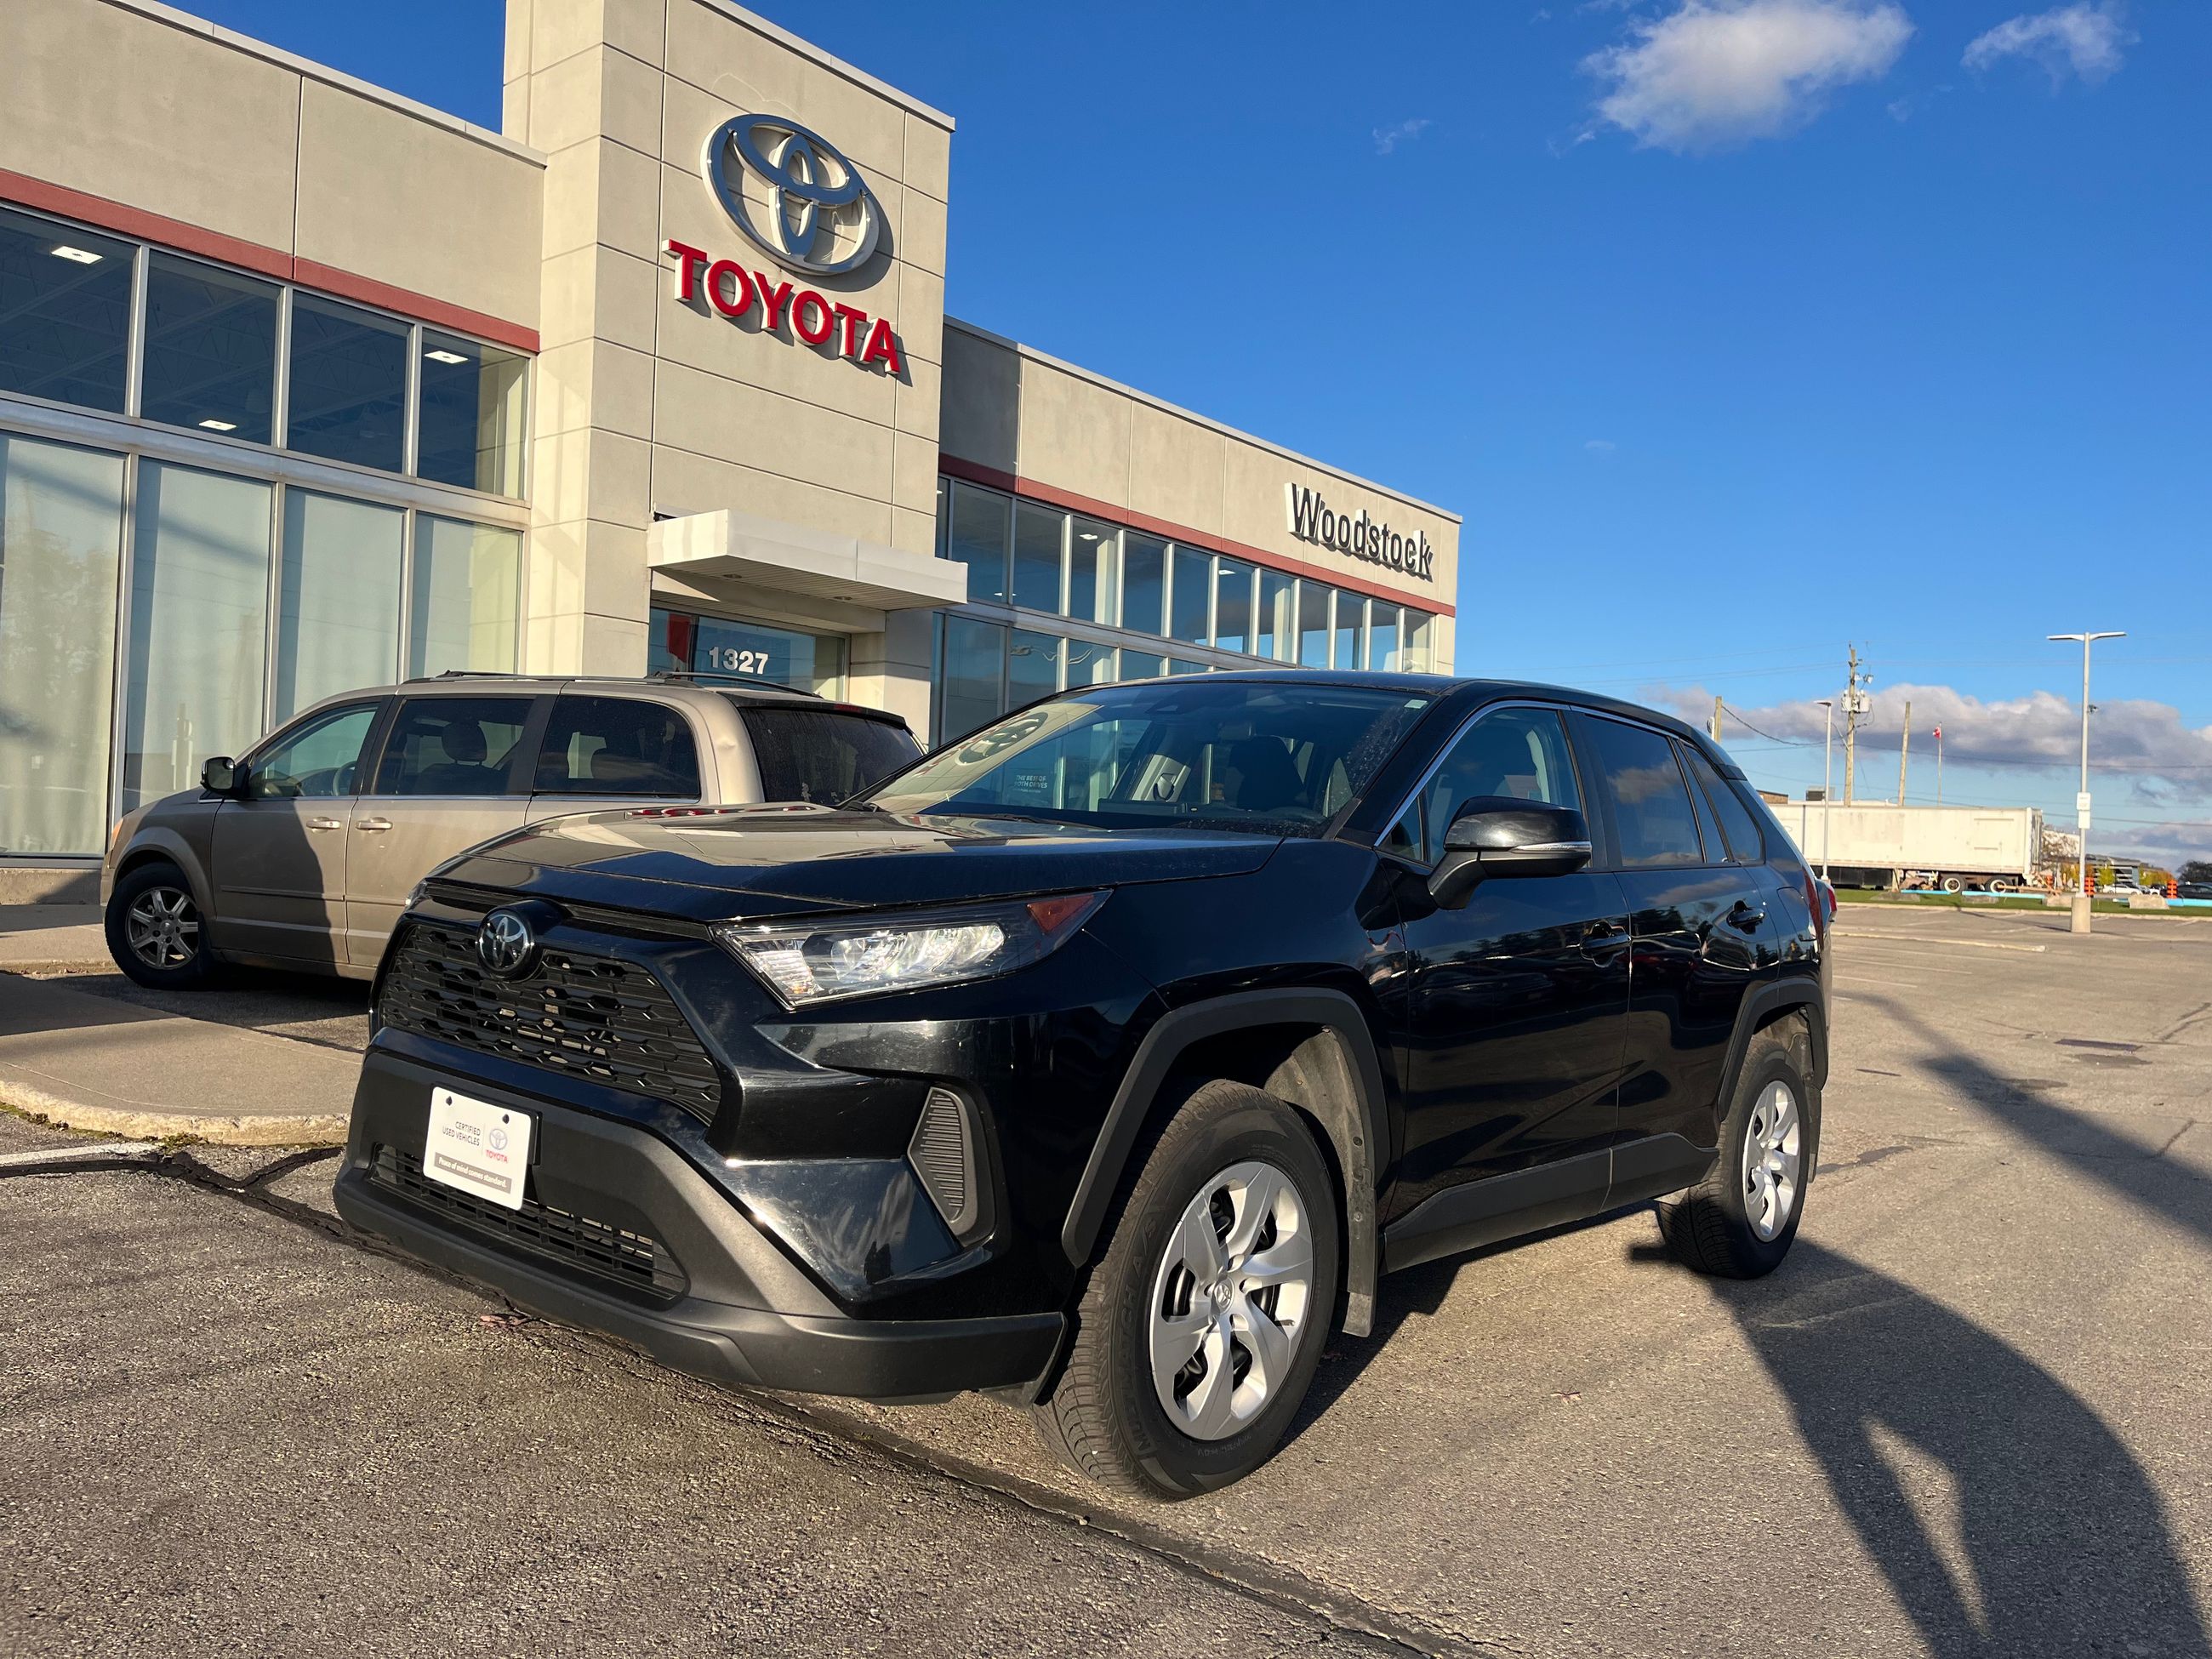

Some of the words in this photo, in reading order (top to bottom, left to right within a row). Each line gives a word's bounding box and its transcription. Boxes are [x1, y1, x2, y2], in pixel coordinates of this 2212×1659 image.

[663, 238, 899, 373] TOYOTA
[1286, 482, 1432, 575] Woodstock
[709, 646, 769, 675] 1327
[442, 1126, 455, 1137] USED
[456, 1132, 480, 1146] VEHICLES
[455, 1121, 481, 1136] CERTIFIED
[486, 1149, 508, 1163] TOYOTA
[456, 1164, 469, 1175] mind
[468, 1169, 483, 1180] comes
